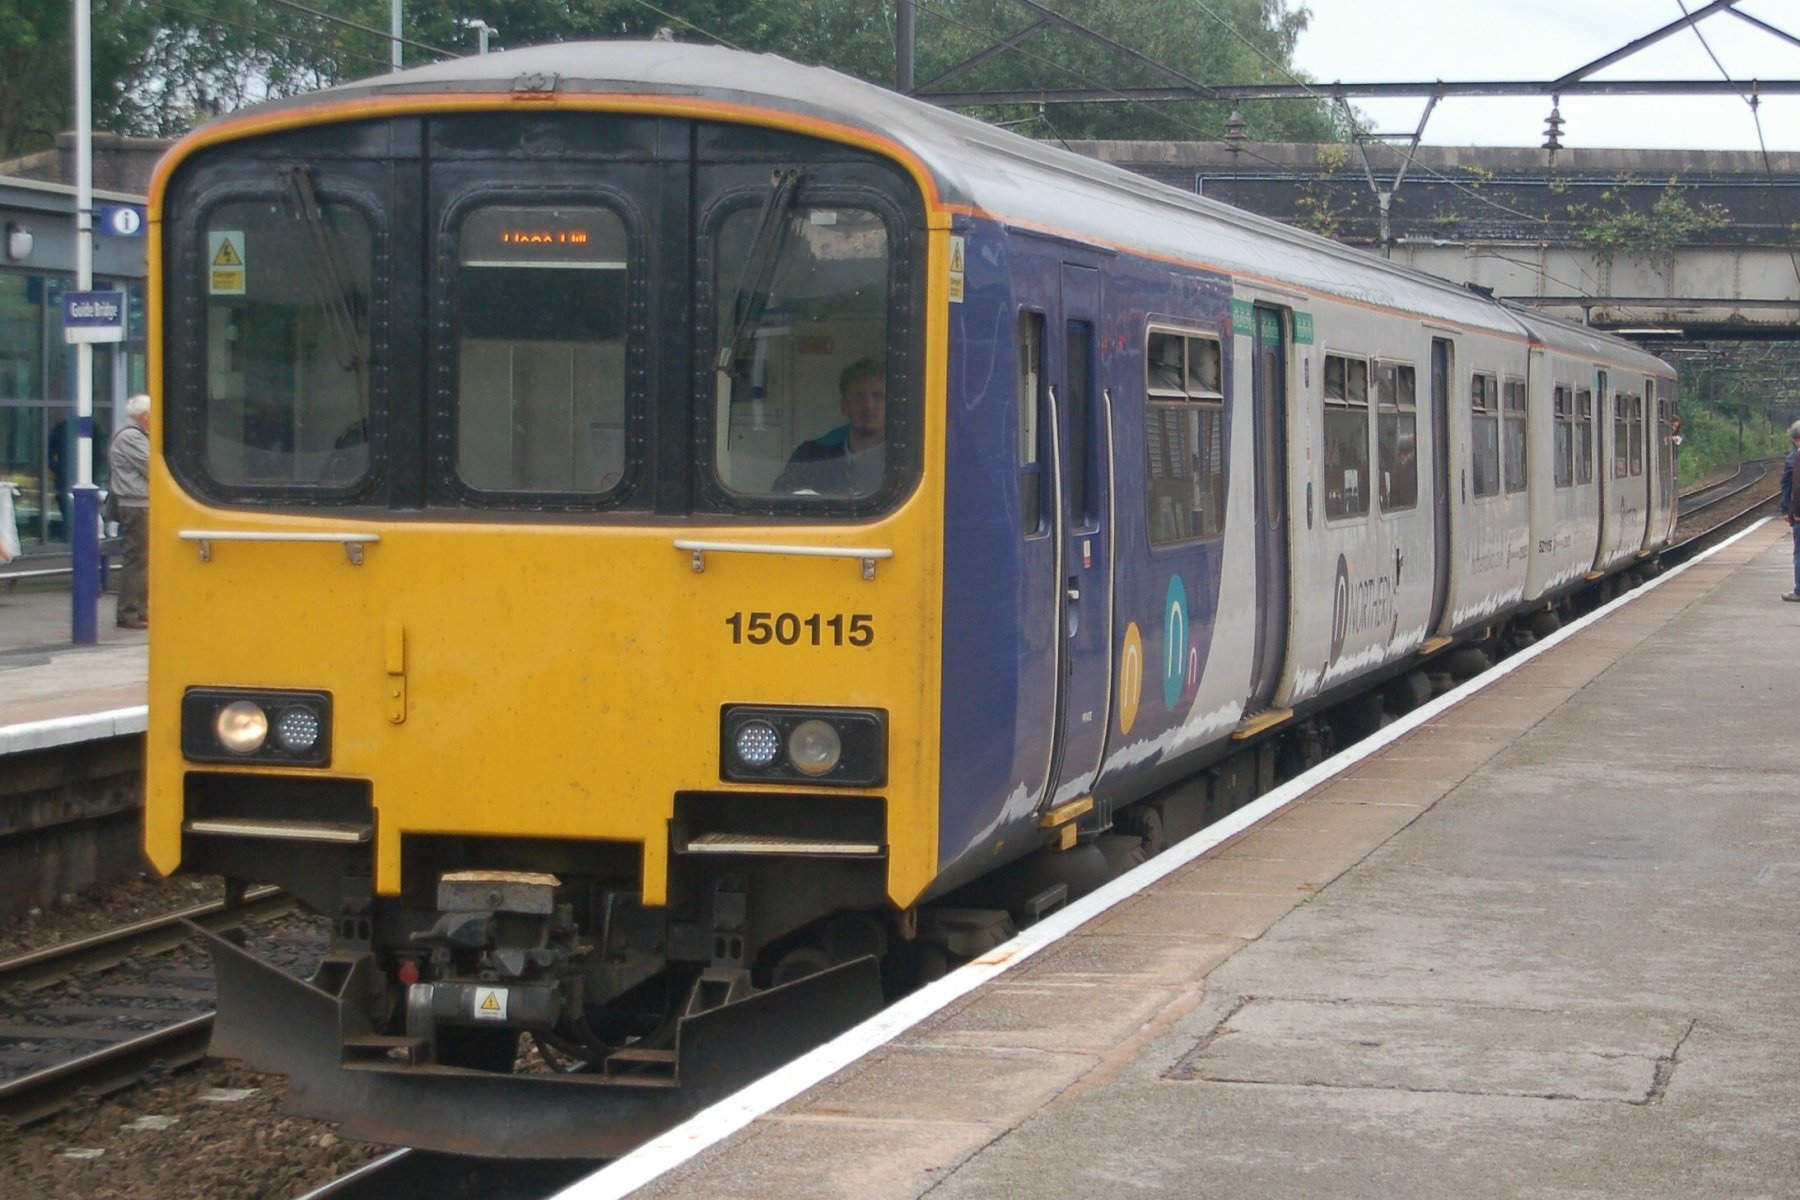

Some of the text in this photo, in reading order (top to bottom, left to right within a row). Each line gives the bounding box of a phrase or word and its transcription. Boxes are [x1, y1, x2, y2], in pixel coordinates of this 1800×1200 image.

[71, 302, 118, 320] Guide Bridge
[1348, 576, 1394, 635] NORTHERN
[725, 611, 875, 647] 150115
